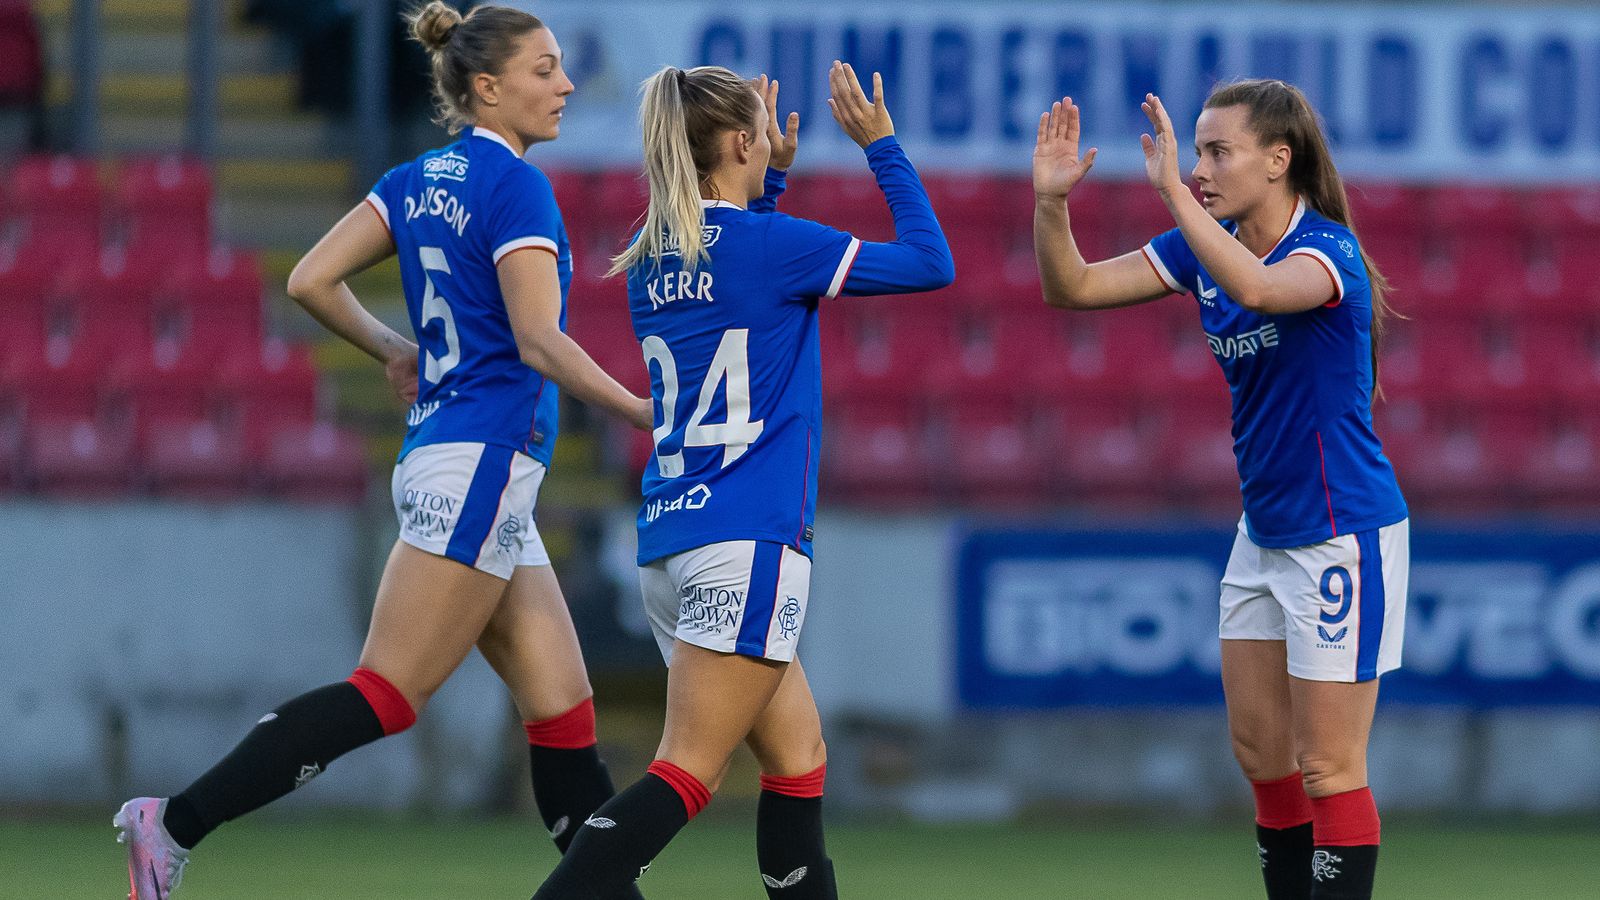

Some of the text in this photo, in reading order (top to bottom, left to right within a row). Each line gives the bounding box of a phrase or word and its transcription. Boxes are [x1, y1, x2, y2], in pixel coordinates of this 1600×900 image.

[1458, 32, 1600, 153] CO
[419, 246, 460, 384] 5
[647, 270, 713, 311] KERR
[641, 328, 764, 478] 24
[404, 489, 457, 515] OLTON
[684, 585, 744, 608] OLTON
[1319, 565, 1353, 625] 9
